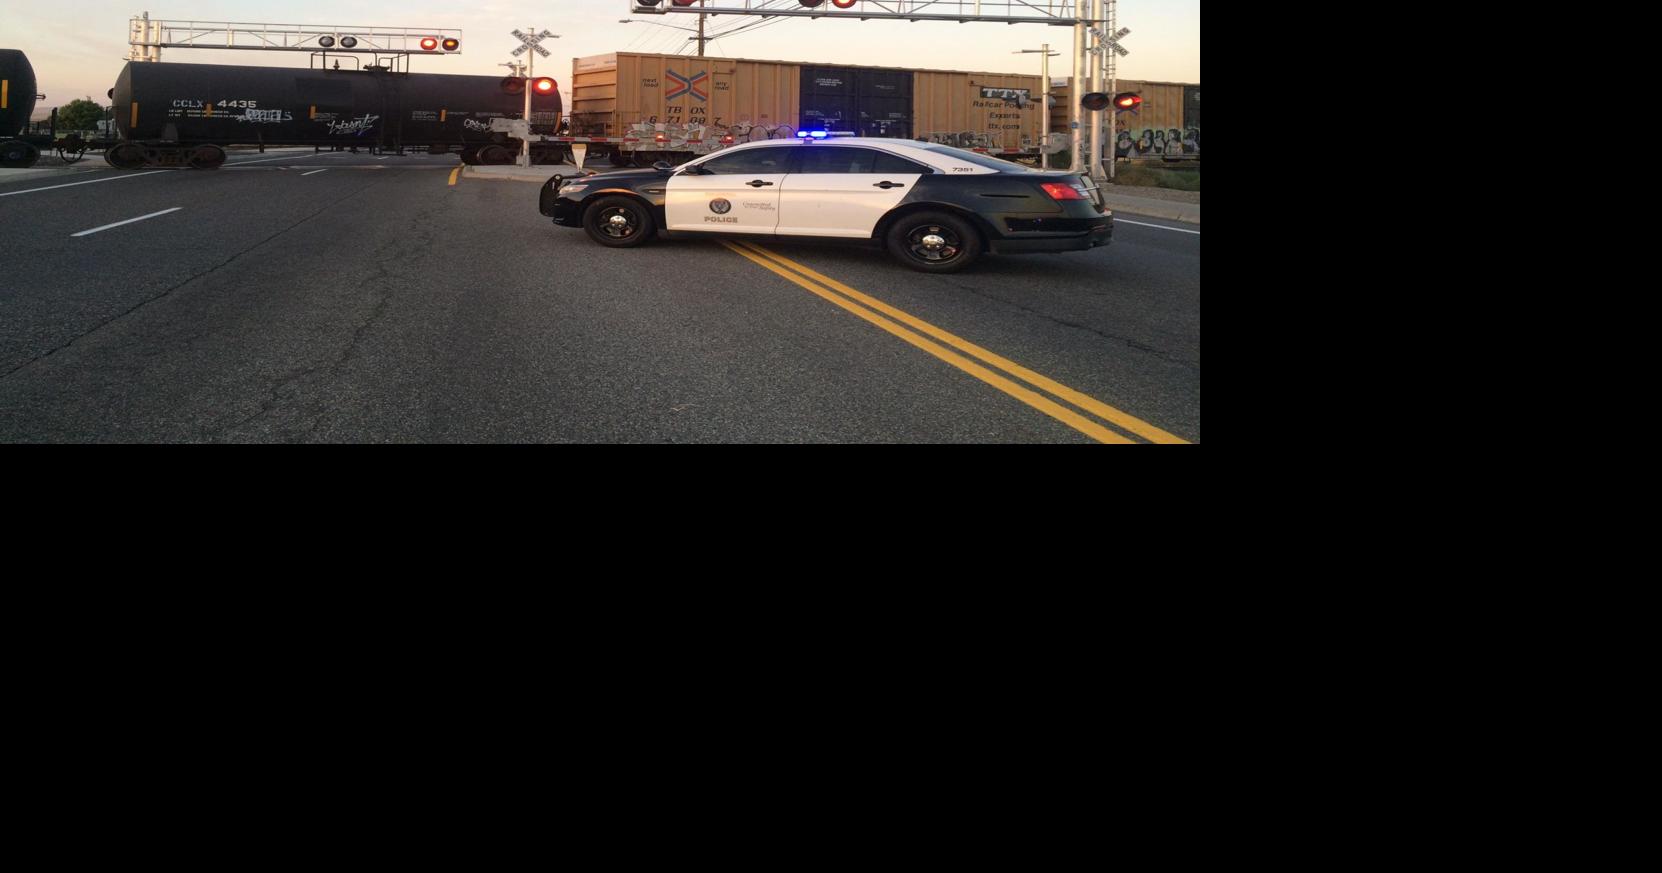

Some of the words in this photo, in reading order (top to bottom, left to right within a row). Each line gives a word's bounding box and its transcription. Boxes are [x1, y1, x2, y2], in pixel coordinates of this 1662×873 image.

[173, 99, 204, 108] CCLX
[216, 99, 257, 108] 4435
[989, 112, 1021, 120] Experts
[703, 216, 739, 224] POLICE
